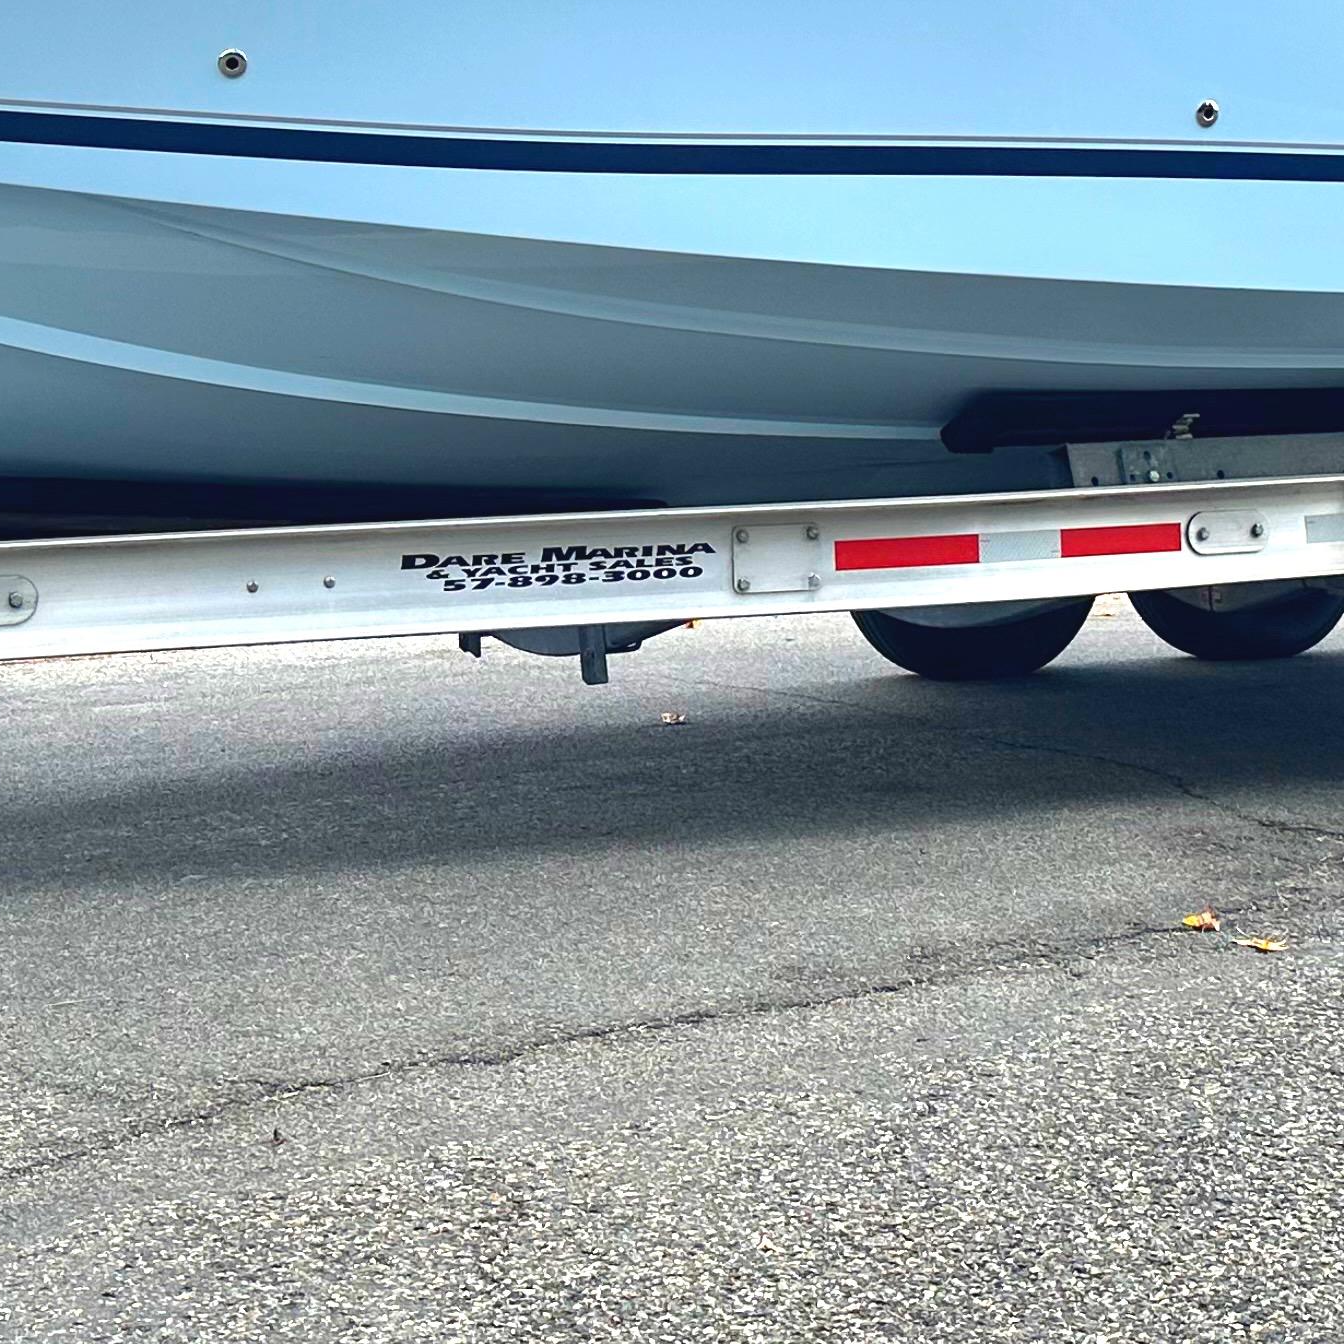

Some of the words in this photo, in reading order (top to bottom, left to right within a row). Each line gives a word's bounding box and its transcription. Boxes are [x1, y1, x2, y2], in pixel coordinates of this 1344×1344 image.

[400, 552, 527, 570] DARE
[540, 542, 717, 563] MARINA
[425, 568, 450, 580] &
[461, 562, 579, 579] YACHT
[588, 555, 693, 572] SALES
[443, 565, 704, 592] 57-898-3000
